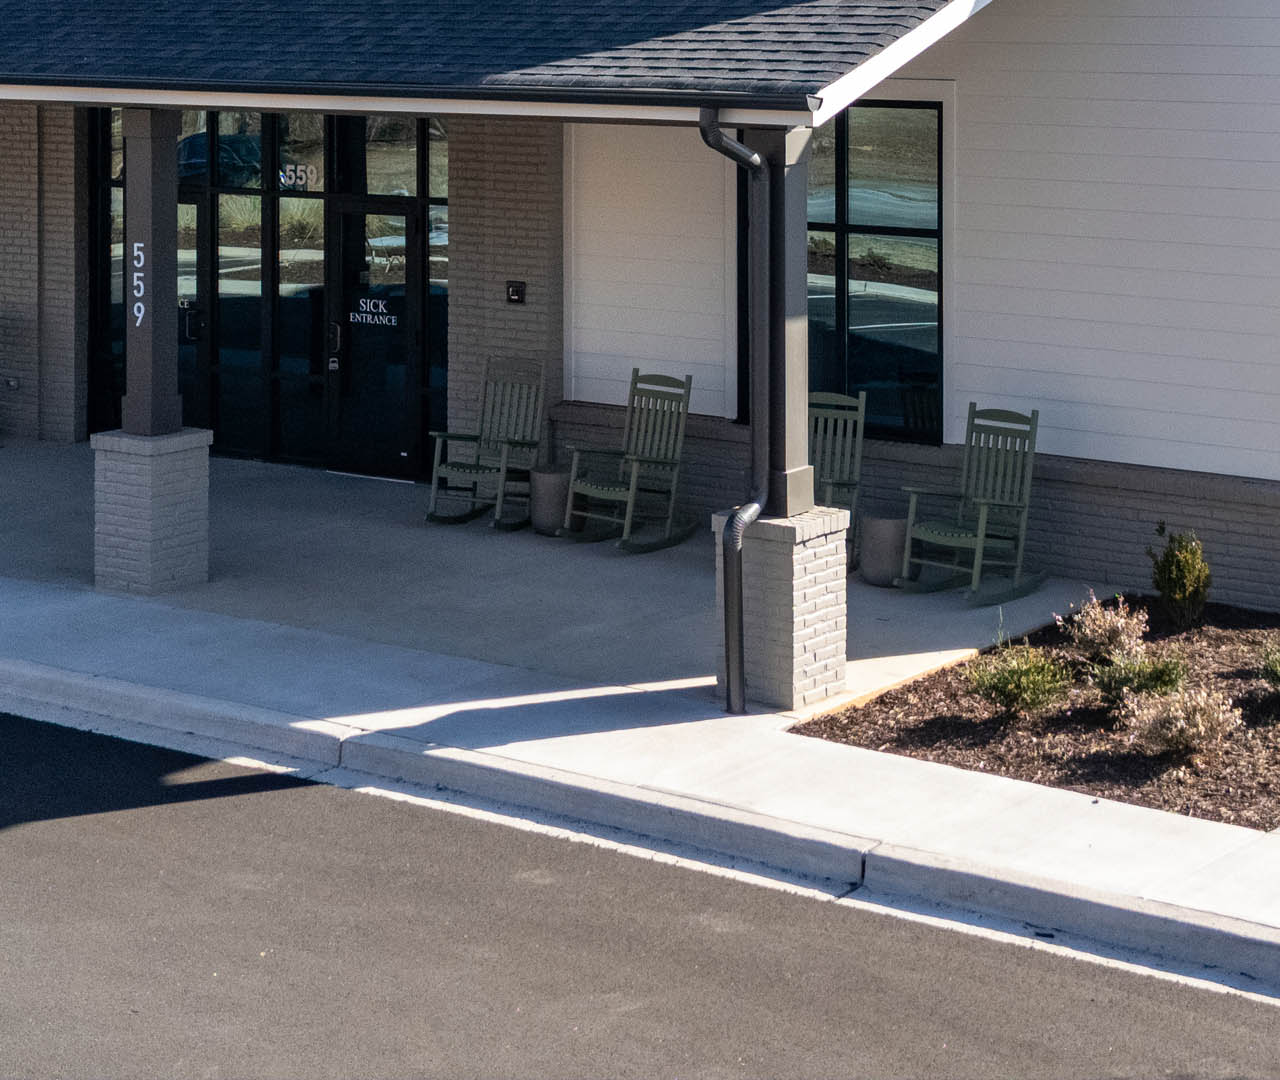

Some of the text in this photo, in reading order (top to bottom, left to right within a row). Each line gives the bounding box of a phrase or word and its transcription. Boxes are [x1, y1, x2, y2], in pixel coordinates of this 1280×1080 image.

[286, 164, 318, 186] 559
[359, 298, 388, 313] SICK
[349, 312, 398, 326] ENTRANCE
